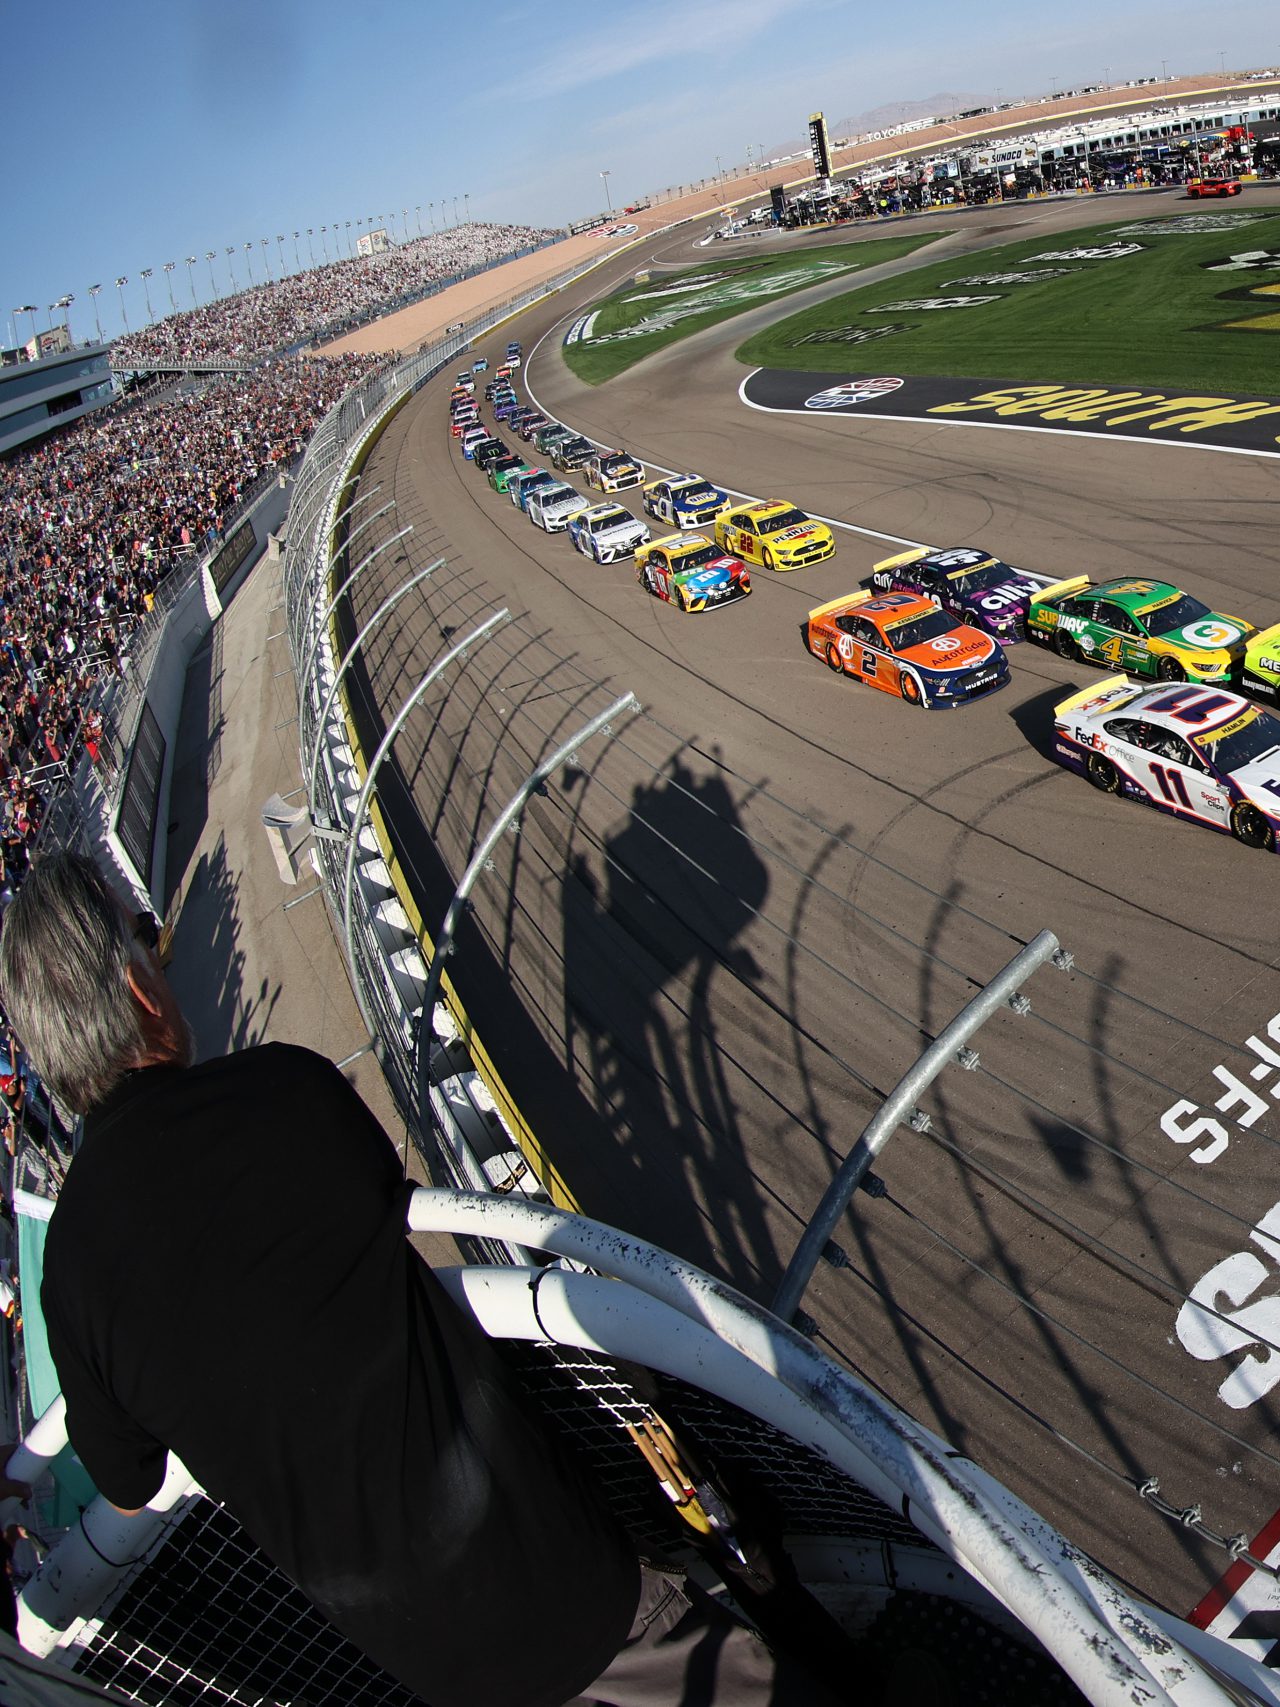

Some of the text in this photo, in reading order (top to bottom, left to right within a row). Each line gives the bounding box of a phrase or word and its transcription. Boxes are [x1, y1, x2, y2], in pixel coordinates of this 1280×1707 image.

[991, 149, 1022, 164] SUNOCO
[689, 491, 714, 502] NAPA
[660, 501, 667, 517] 9
[740, 532, 754, 555] 22
[773, 523, 820, 544] PENNZOIL
[981, 580, 1042, 610] ally
[1151, 597, 1175, 609] HARVICK
[897, 610, 930, 625] KESELOWSKI
[1037, 609, 1090, 635] SUBWAY
[932, 638, 990, 667] Autotrader
[1100, 634, 1124, 665] 4
[861, 649, 878, 678] 2
[965, 672, 998, 691] MUSTANG
[1077, 684, 1136, 712] FedEx
[1142, 686, 1237, 725] 11
[1221, 716, 1247, 735] HAMLIN
[1075, 726, 1109, 753] FedEx
[1109, 744, 1135, 764] Office
[1148, 761, 1196, 812] 11
[1200, 790, 1221, 804] Sport
[1207, 799, 1226, 813] Clips
